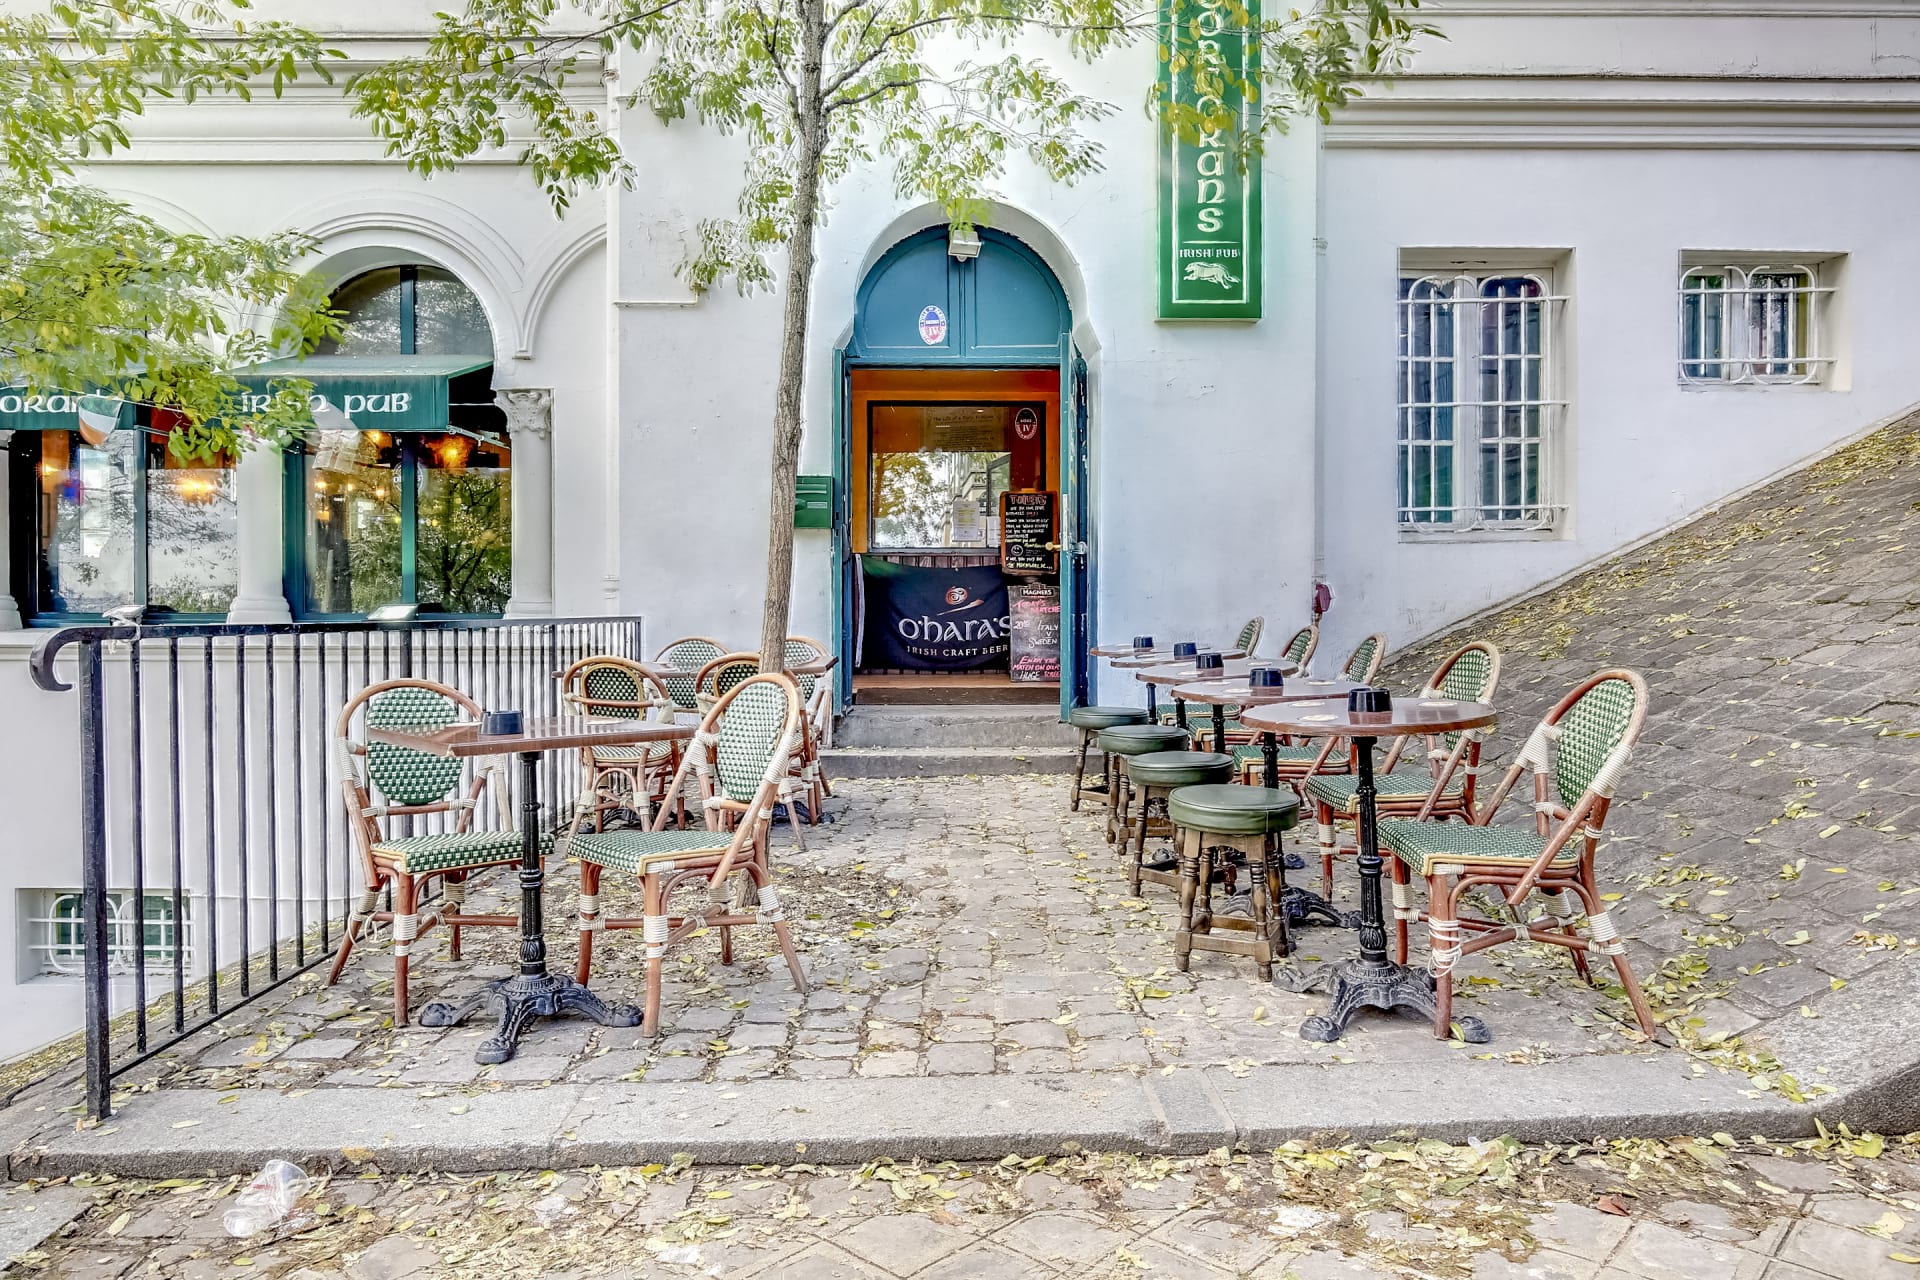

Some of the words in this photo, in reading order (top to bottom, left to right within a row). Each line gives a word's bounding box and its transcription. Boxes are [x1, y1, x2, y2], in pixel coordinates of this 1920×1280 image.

[1179, 248, 1212, 258] IRISH
[1215, 248, 1240, 258] PUB
[343, 392, 412, 419] PUB
[1022, 588, 1053, 596] MAGNERS
[1028, 637, 1058, 649] SWEDEN
[906, 645, 938, 656] IRISH
[943, 648, 978, 657] CRAFT
[982, 644, 1009, 655] BEER
